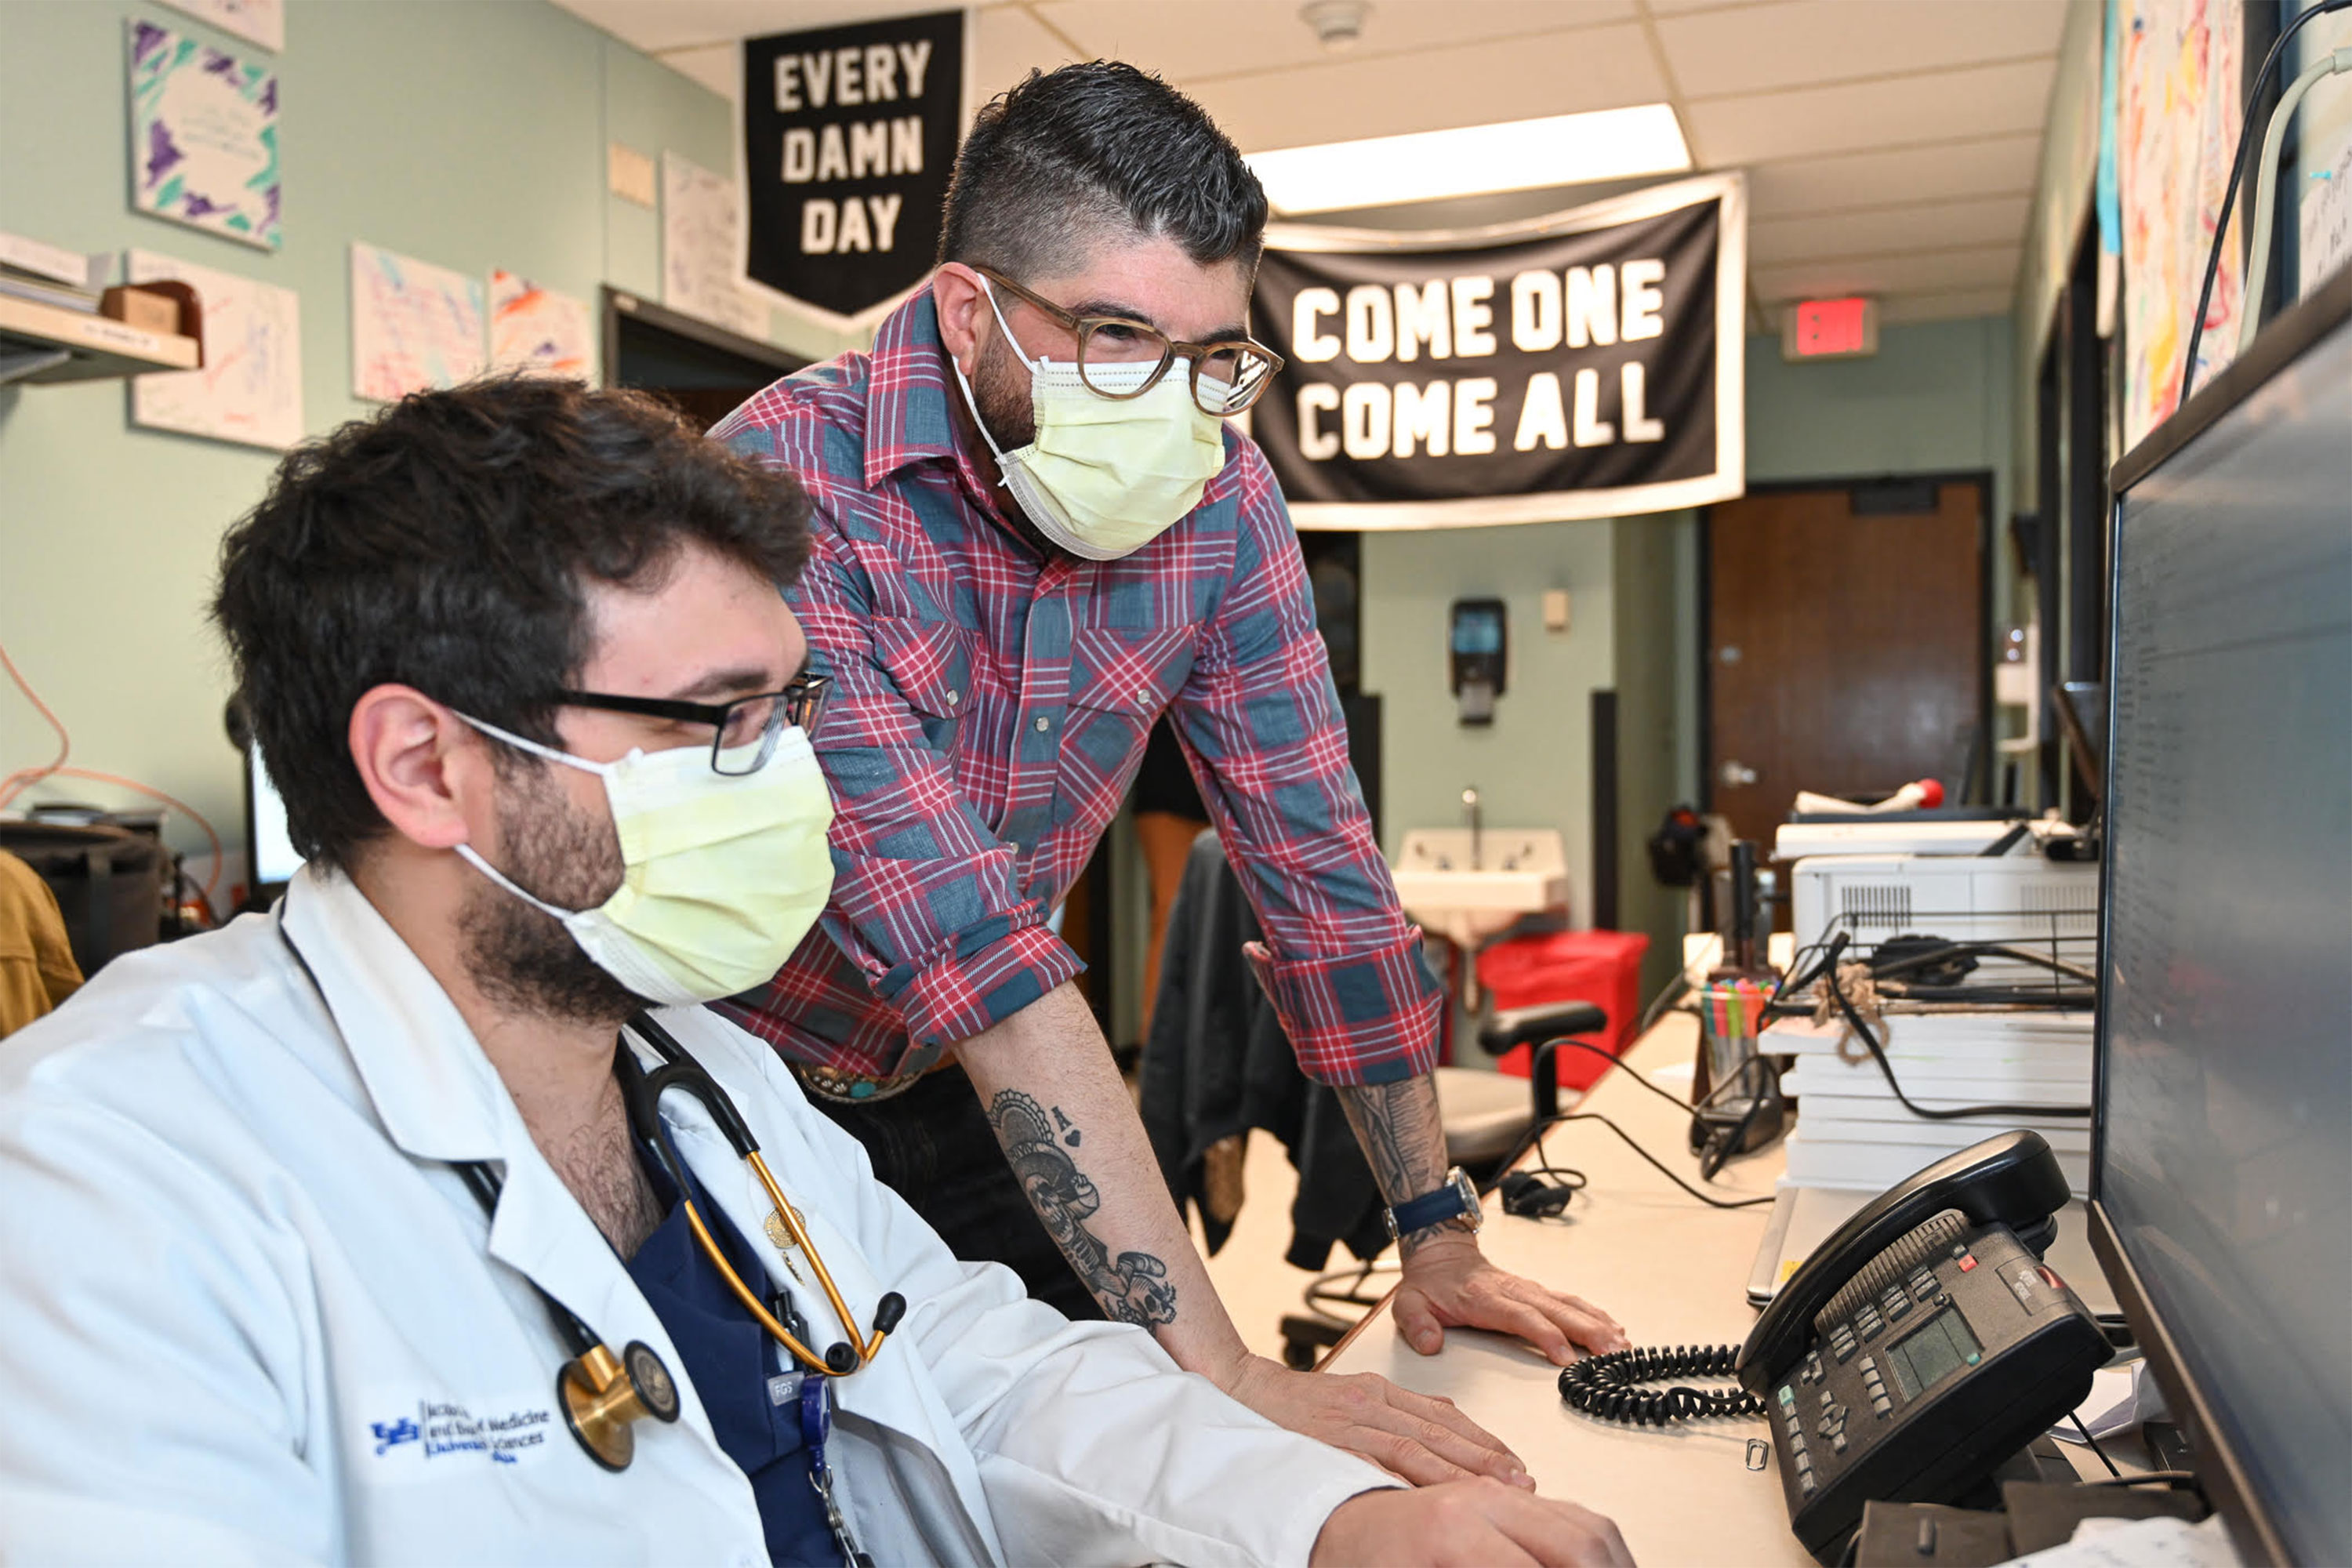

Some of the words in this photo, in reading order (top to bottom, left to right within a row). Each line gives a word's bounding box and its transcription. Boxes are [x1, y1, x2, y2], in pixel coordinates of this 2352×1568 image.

[774, 41, 931, 112] EVERY
[782, 115, 924, 183] DAMN
[800, 194, 902, 254] DAY
[1293, 275, 1497, 363] COME
[1512, 258, 1665, 352] ONE
[1296, 377, 1497, 461] COME
[1513, 361, 1665, 452] ALL
